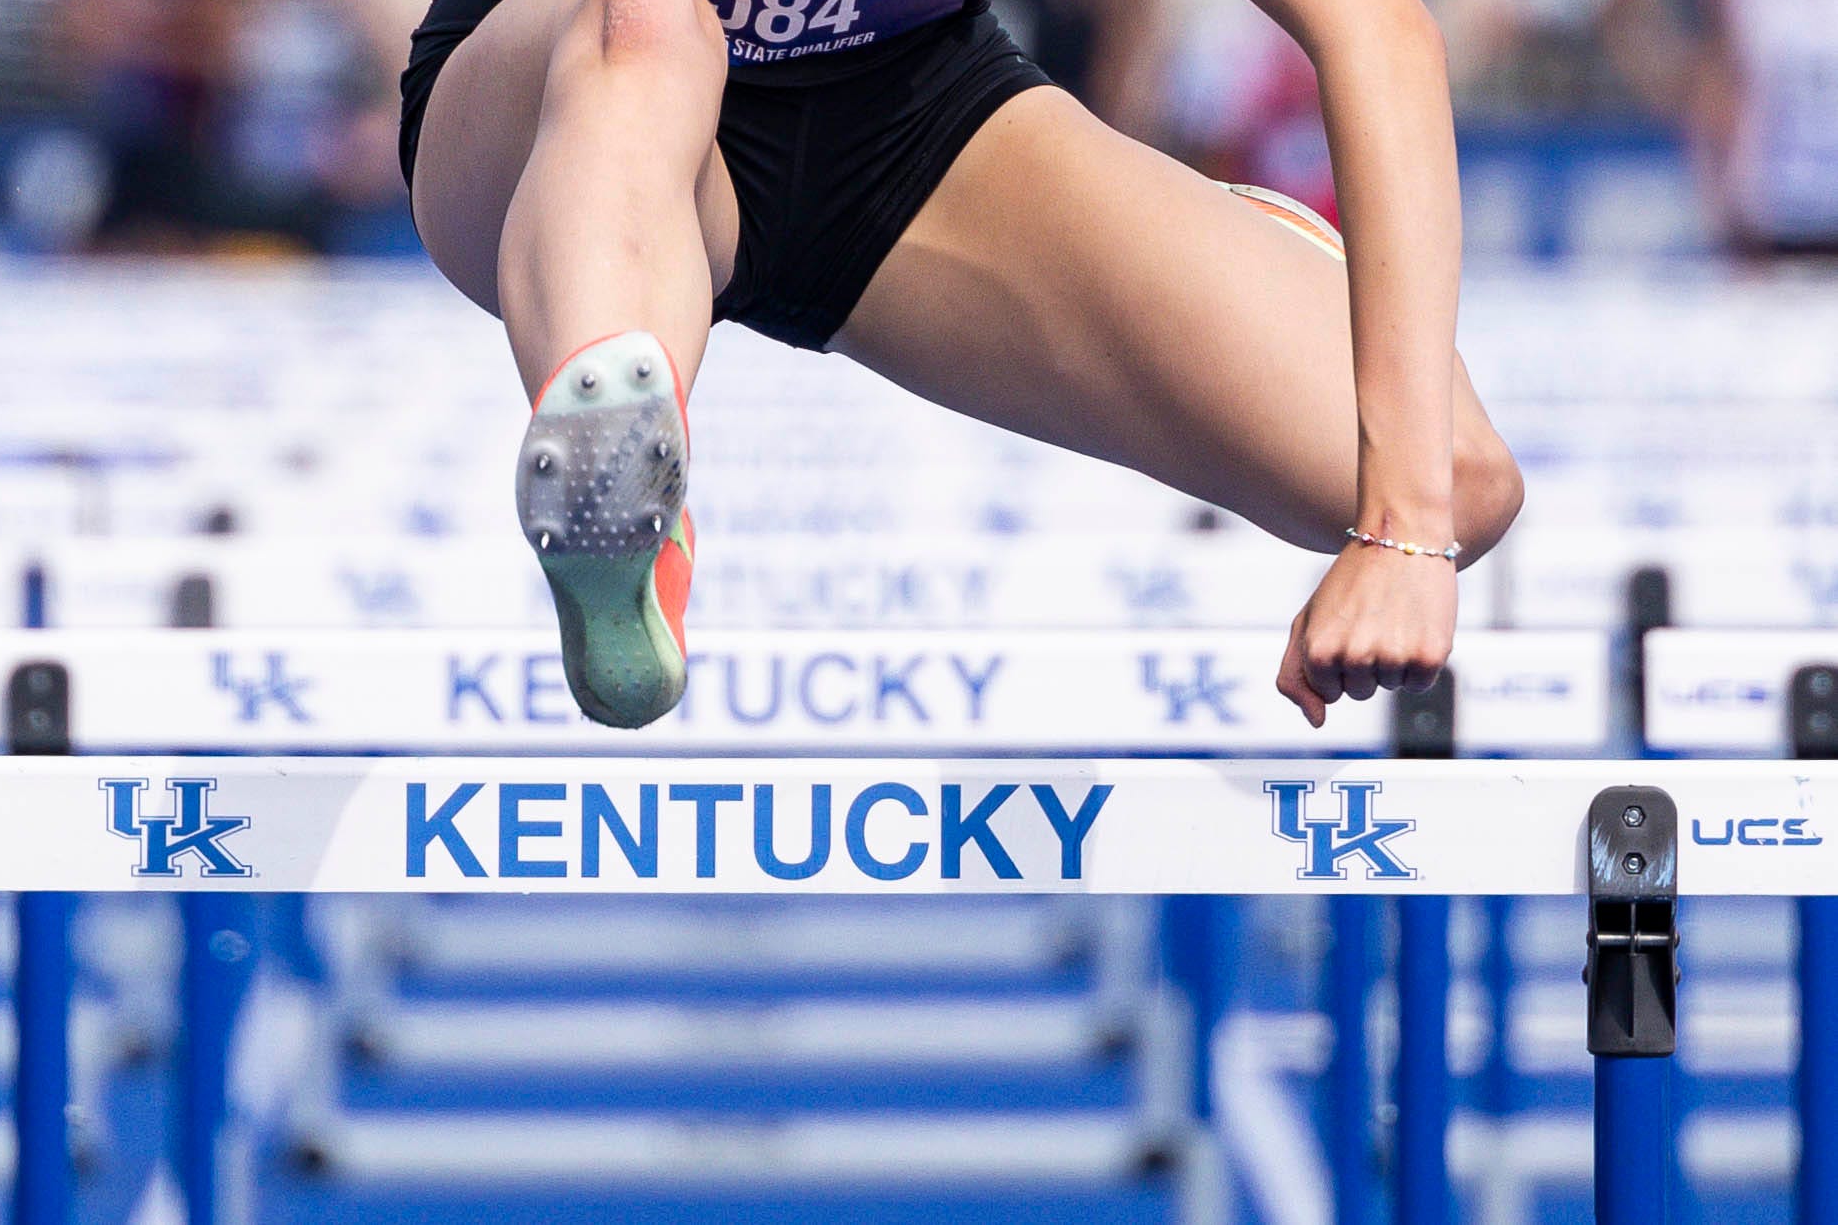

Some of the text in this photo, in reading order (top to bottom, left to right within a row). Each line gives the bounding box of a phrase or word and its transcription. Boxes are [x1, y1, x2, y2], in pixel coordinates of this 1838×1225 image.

[733, 38, 788, 63] STATE
[789, 32, 876, 58] QUALIFIER
[446, 651, 1004, 726] KETUCKY
[98, 777, 252, 877] UK
[406, 783, 1114, 881] KENTUCKY
[1263, 780, 1417, 881] UK
[1692, 818, 1824, 846] UCS
